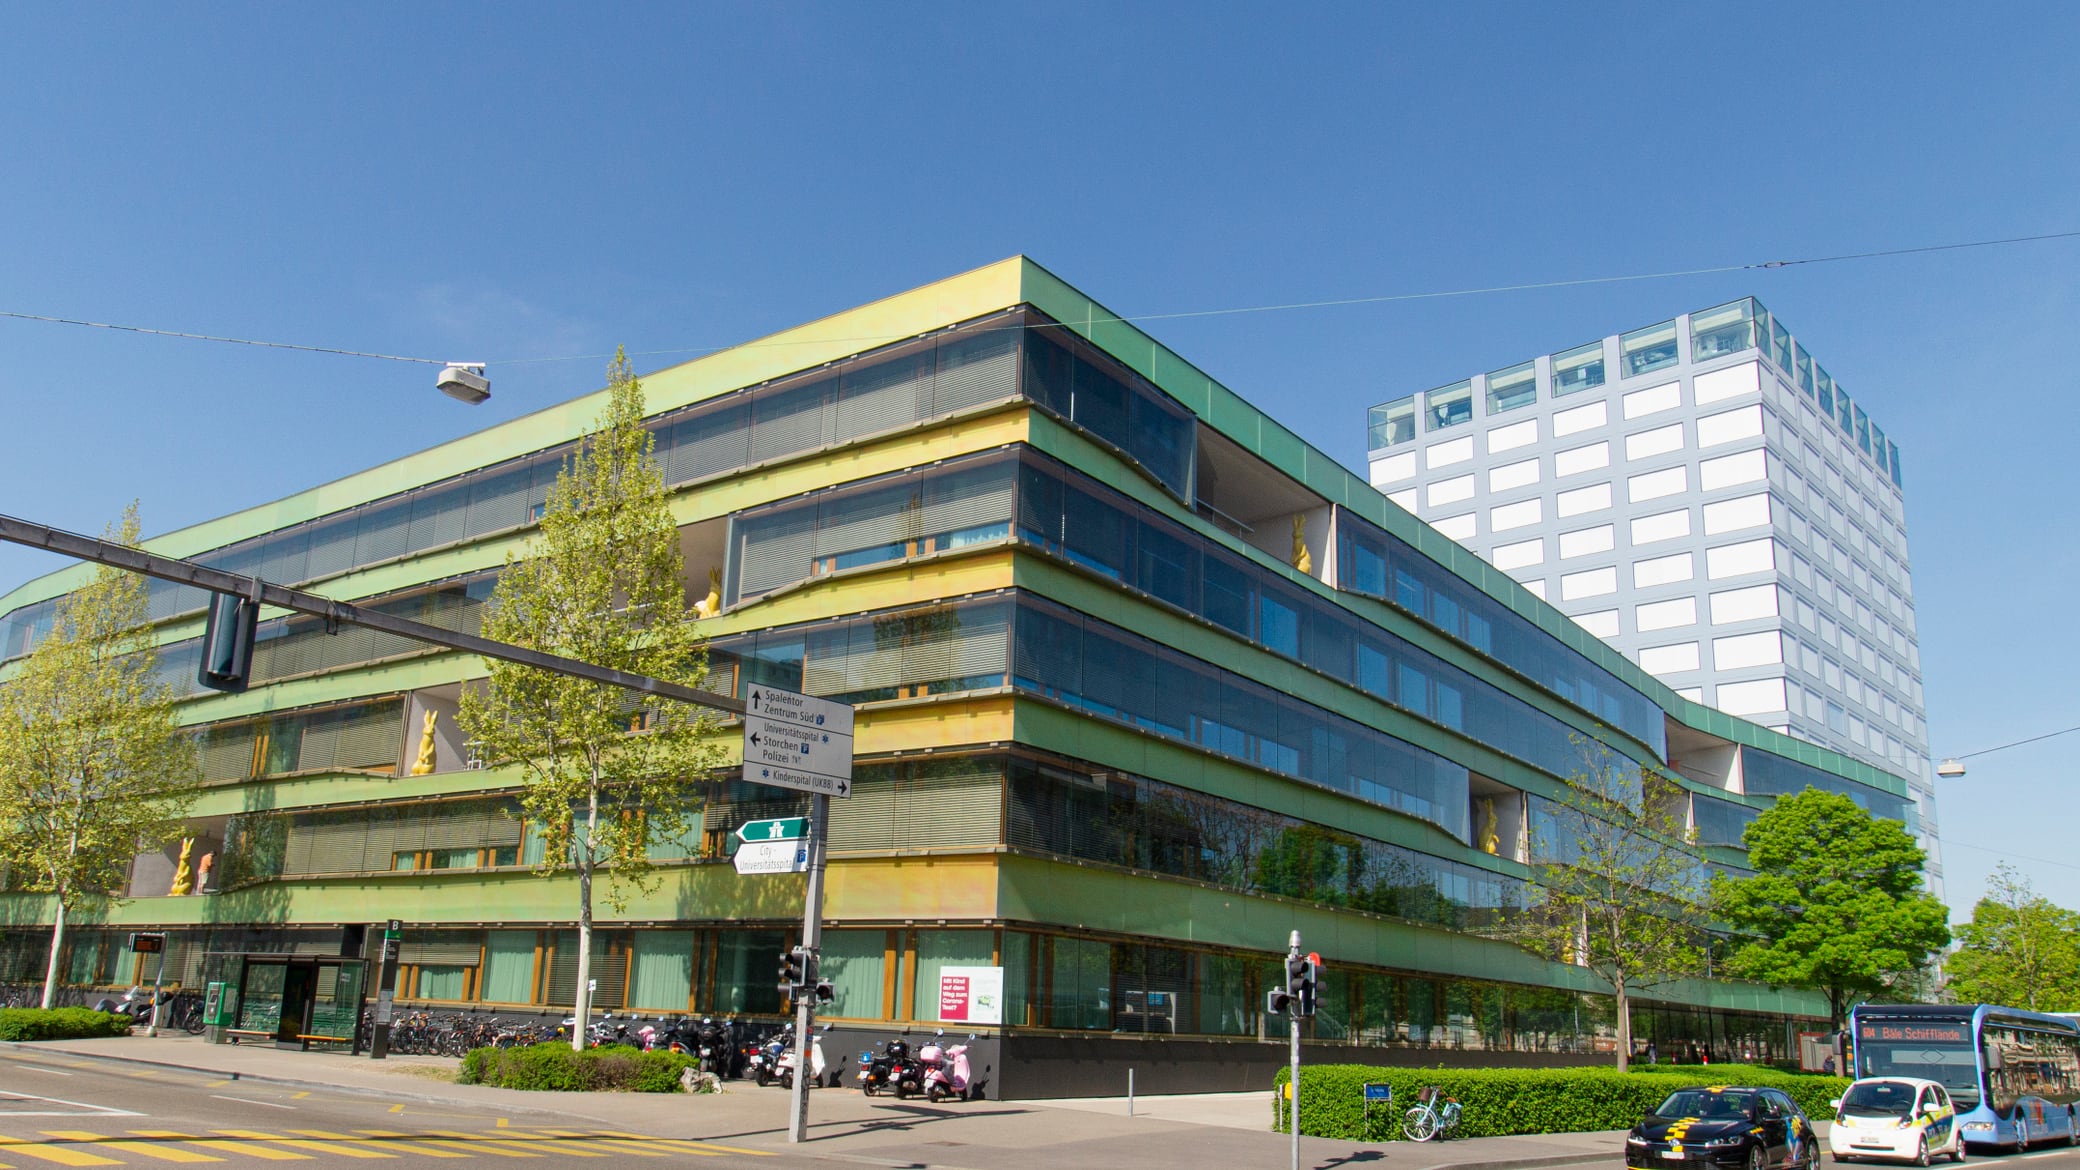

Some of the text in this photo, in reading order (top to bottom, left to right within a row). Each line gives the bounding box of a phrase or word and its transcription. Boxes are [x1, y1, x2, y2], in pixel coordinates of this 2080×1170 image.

[765, 690, 803, 707] Spalentor
[764, 704, 798, 719] Zentrum
[800, 711, 814, 723] Süd
[764, 722, 819, 742] Universitätsspital
[763, 736, 798, 752] Storchen
[763, 749, 789, 763] Polizei
[773, 770, 811, 786] Kinderspital
[392, 921, 399, 930] B
